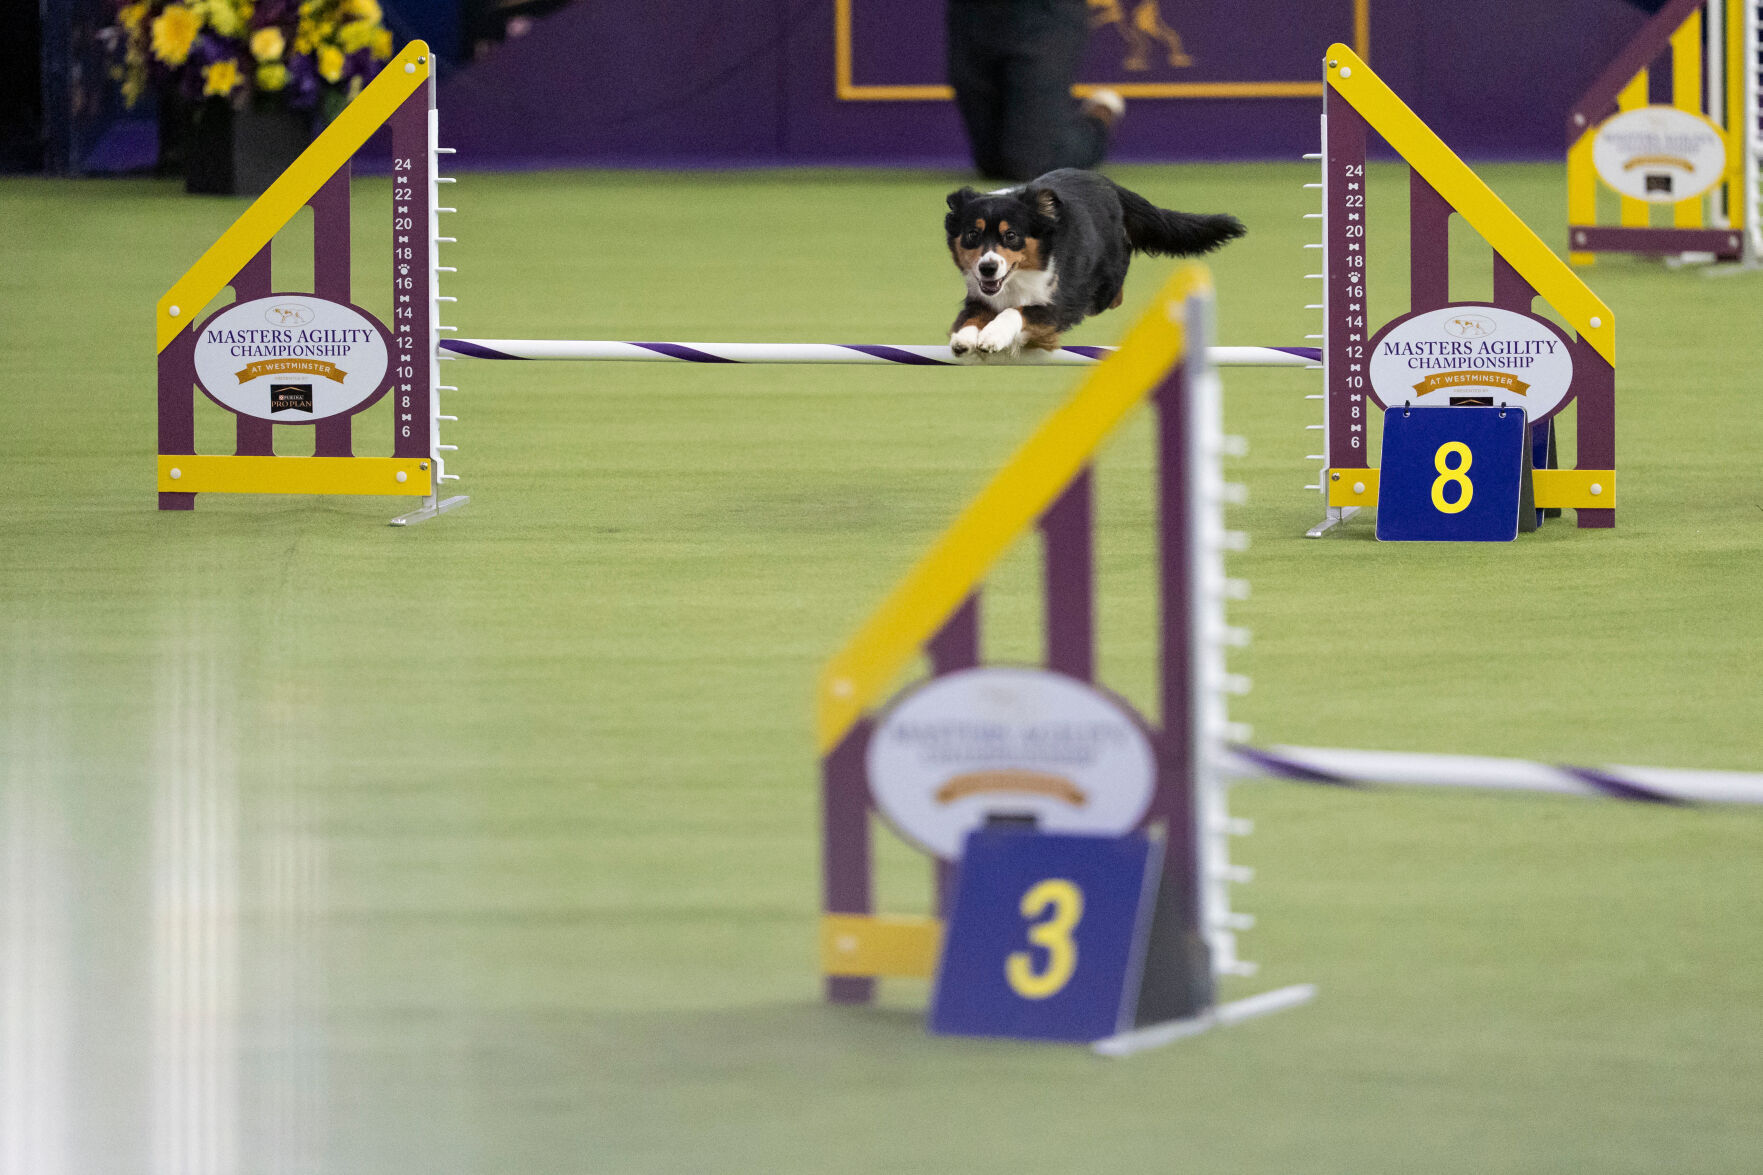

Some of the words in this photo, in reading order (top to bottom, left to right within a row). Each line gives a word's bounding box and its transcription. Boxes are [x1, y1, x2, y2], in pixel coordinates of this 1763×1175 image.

[394, 158, 412, 171] 24
[1345, 164, 1363, 177] 24
[395, 188, 412, 200] 22
[1345, 195, 1363, 207] 22
[395, 218, 412, 230] 20
[1345, 225, 1363, 237] 20
[395, 248, 412, 259] 18
[1345, 255, 1363, 268] 18
[395, 277, 413, 289] 16
[1345, 285, 1363, 298] 16
[396, 307, 413, 319] 14
[1345, 315, 1363, 328] 14
[207, 329, 292, 344] MASTERS
[297, 329, 373, 344] AGILITY
[396, 337, 413, 349] 12
[1383, 340, 1473, 356] MASTERS
[1477, 340, 1559, 355] AGILITY
[230, 345, 351, 357] CHAMPIONSHIP
[1345, 345, 1363, 358] 12
[265, 362, 332, 373] WESTMINSTER
[1407, 356, 1535, 369] CHAMPIONSHIP
[396, 366, 413, 378] 10
[1345, 376, 1363, 388] 10
[1430, 377, 1441, 386] AT
[1444, 374, 1514, 386] WESTMINSTER
[289, 400, 312, 408] PLAN
[401, 396, 411, 408] 8
[1351, 406, 1360, 418] 8
[402, 425, 411, 437] 6
[1351, 436, 1360, 448] 6
[1431, 441, 1474, 514] 8
[1004, 877, 1085, 1000] 3
